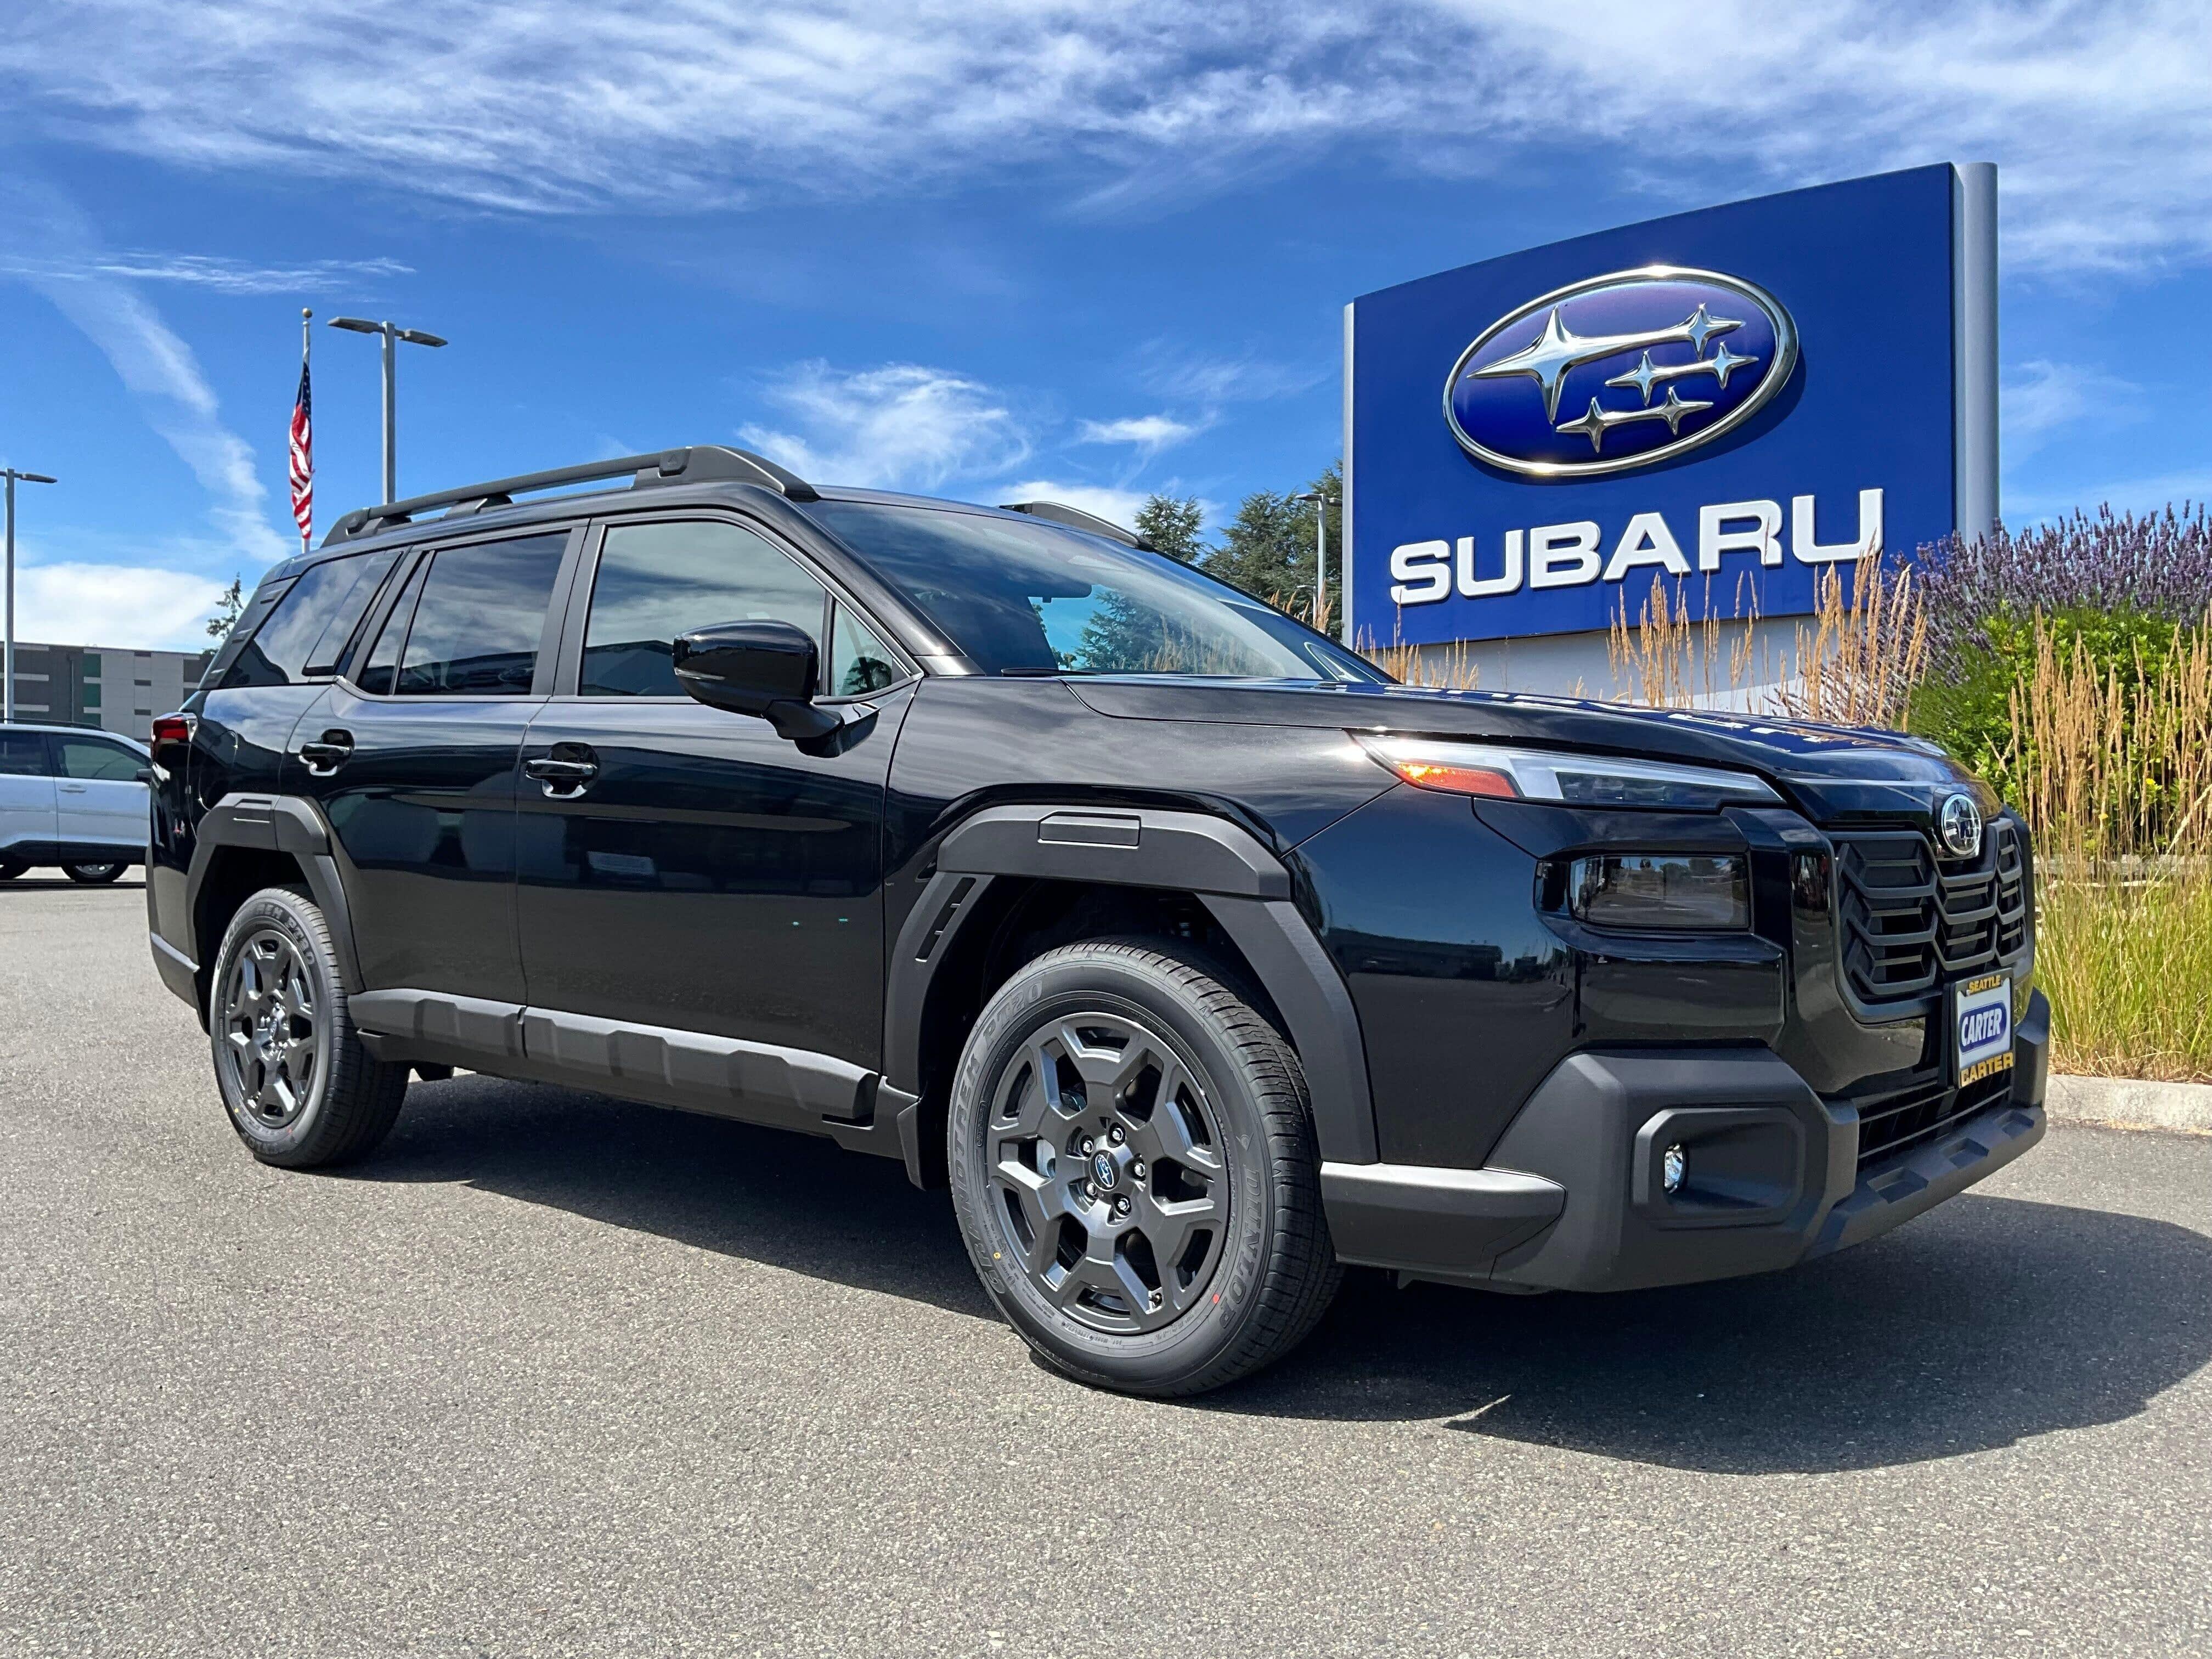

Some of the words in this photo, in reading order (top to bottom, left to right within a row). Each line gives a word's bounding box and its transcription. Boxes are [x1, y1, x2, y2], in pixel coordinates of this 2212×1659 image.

[1390, 488, 1884, 605] SUBARU
[1968, 974, 2001, 994] SEATTLE
[1961, 1007, 2003, 1047] CARTER
[1960, 1052, 2014, 1087] CARTER
[953, 1052, 1005, 1294] GRANDTREK
[983, 980, 1042, 1043] PT20
[1219, 1165, 1262, 1329] DUNLOP
